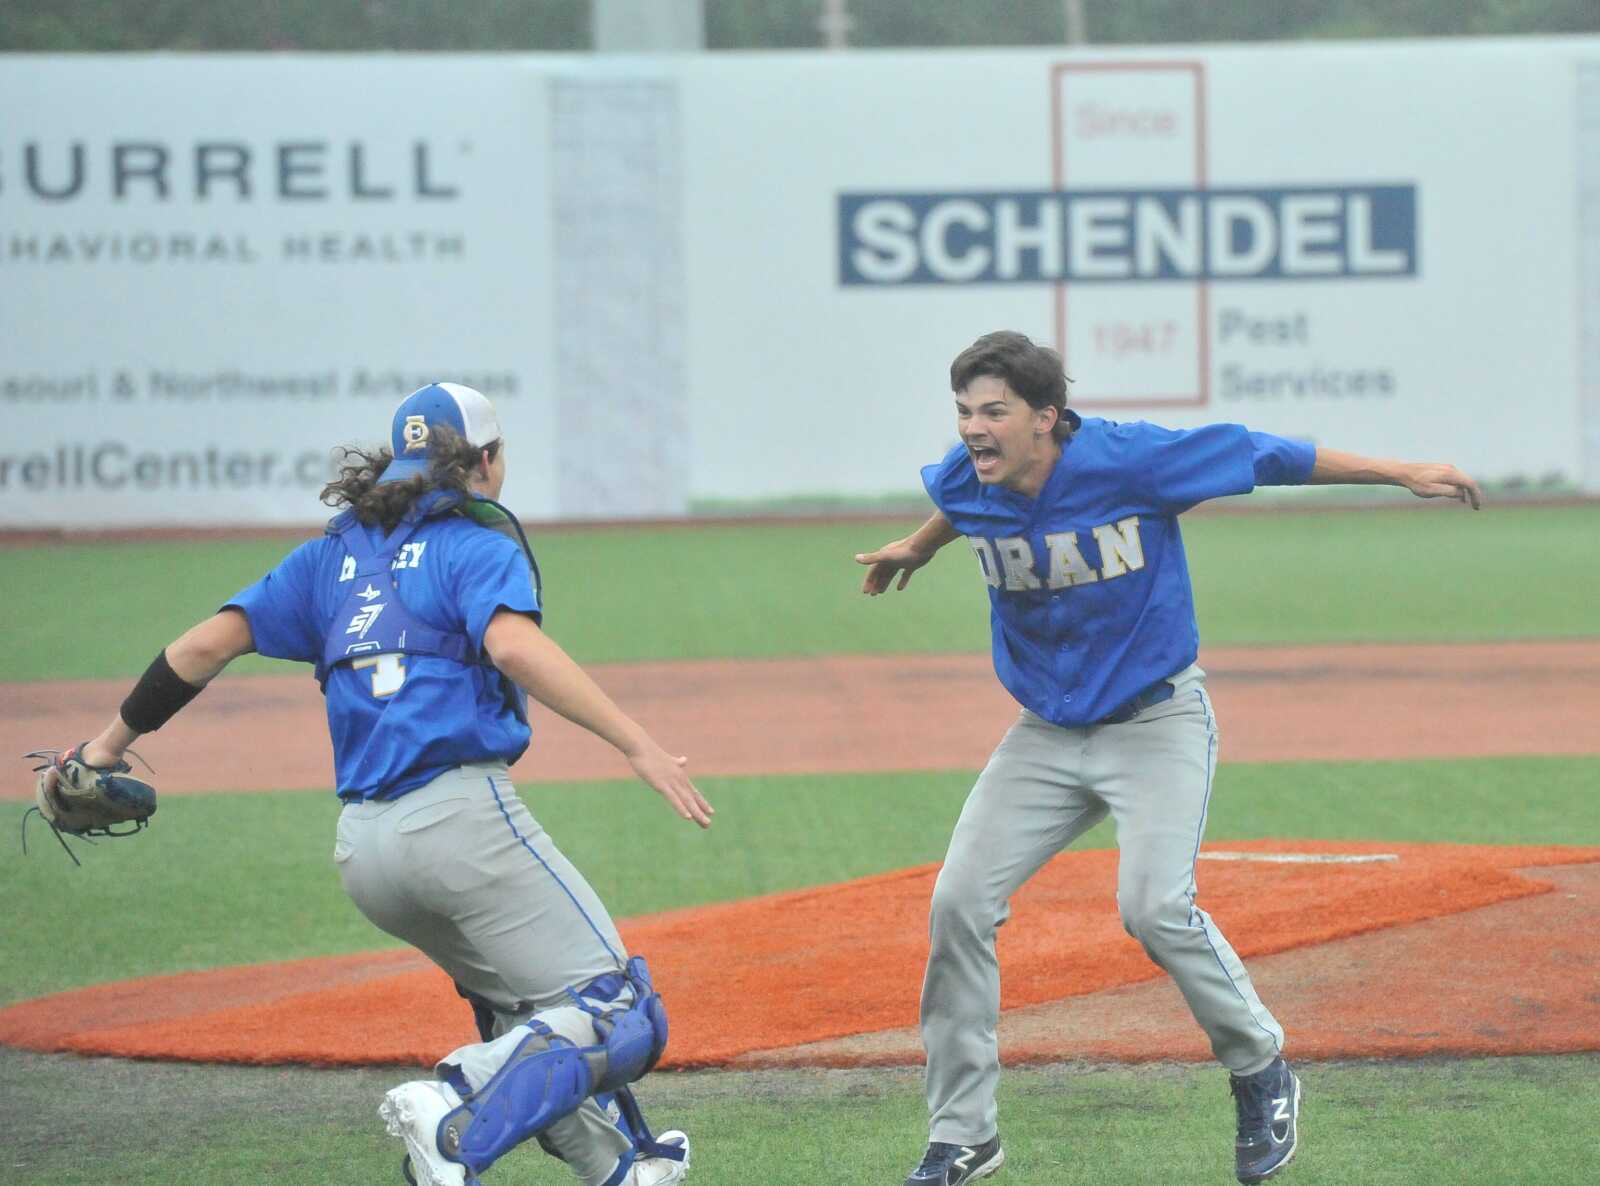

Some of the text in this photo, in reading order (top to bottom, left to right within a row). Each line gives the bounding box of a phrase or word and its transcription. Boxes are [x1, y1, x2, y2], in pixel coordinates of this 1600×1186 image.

[1074, 104, 1177, 138] Since
[0, 142, 460, 201] URRELL
[0, 233, 465, 263] HAVIORAL HEALTH
[851, 194, 1408, 282] SCHENDEL
[1219, 308, 1308, 343] Pest
[0, 369, 98, 401] souri
[1220, 362, 1397, 398] Services
